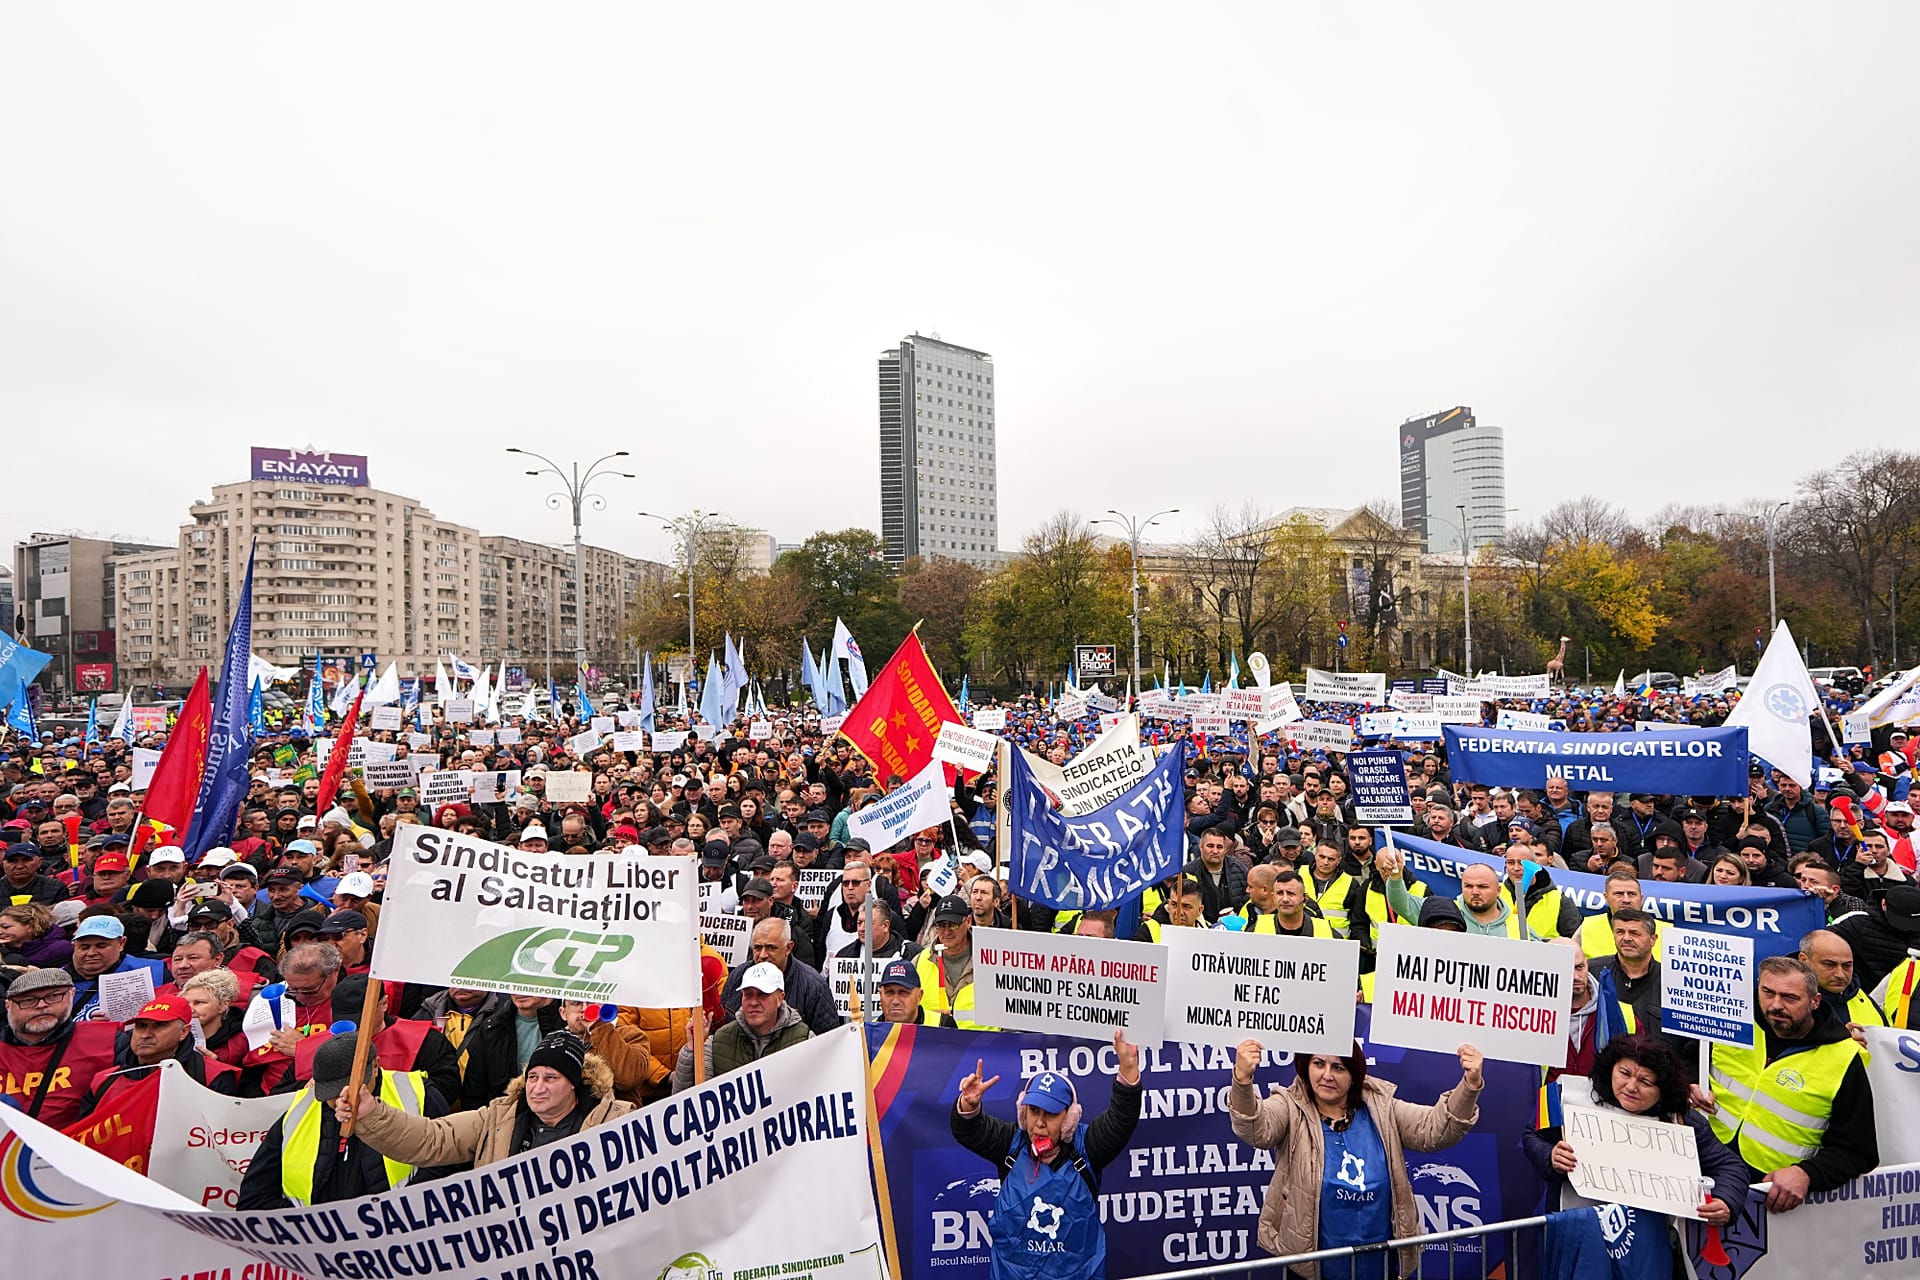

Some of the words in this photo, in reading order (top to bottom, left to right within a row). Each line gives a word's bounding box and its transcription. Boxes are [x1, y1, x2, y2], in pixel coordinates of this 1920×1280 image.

[262, 459, 358, 478] ENAYATI
[1080, 653, 1111, 661] BLACK
[1411, 719, 1438, 727] SMAR
[1518, 719, 1546, 729] SMAR
[1560, 740, 1722, 758] SINDICATELOR
[1062, 744, 1136, 782] FEDERAȚIA
[1353, 757, 1367, 766] NOI
[1368, 756, 1397, 766] PUNEM
[1358, 766, 1390, 775] ORAȘUL
[1061, 760, 1141, 800] SINDICATELO
[1365, 774, 1401, 784] MIȘCARE
[1545, 764, 1614, 782] METAL
[1355, 787, 1370, 795] VOI
[1371, 786, 1404, 796] BLOCAȚI
[1360, 795, 1403, 804] SALARIILE!
[1072, 798, 1094, 815] DIN
[412, 833, 595, 889] Sindicatul
[607, 861, 679, 890] Liber
[431, 873, 466, 903] al
[477, 876, 662, 930] Salariaților
[800, 885, 826, 896] PENTR
[1683, 935, 1731, 951] ORAȘUL
[980, 948, 998, 966] NU
[1002, 950, 1046, 971] PUTEM
[1050, 954, 1095, 976] APĂRA
[1101, 960, 1159, 983] DIGURILE
[1668, 945, 1675, 954] E
[1678, 945, 1690, 957] ÎN
[1693, 949, 1746, 966] MIȘCARE
[1192, 952, 1271, 978] OTRĂVURILE
[1274, 960, 1295, 980] DIN
[1300, 962, 1327, 982] APE
[1396, 953, 1429, 982] MAI
[1433, 958, 1490, 993] PUȚINI
[1496, 966, 1560, 999] OAMENI
[1671, 959, 1743, 981] DATORITA
[450, 976, 497, 988] COMPANIA
[512, 984, 561, 996] TRANSPORT
[563, 990, 591, 999] PUBLIC
[995, 973, 1052, 995] MUNCIND
[1057, 980, 1073, 998] PE
[1077, 982, 1140, 1005] SALARIUL
[1234, 983, 1252, 1002] NE
[1255, 986, 1282, 1005] FAC
[1683, 976, 1731, 994] NOUĂ!
[143, 1003, 170, 1013] SLPR
[1667, 987, 1694, 999] VREM
[1697, 992, 1748, 1010] DREPTATE,
[1670, 997, 1684, 1006] NU
[1686, 1000, 1742, 1017] RESTRICȚII!
[1005, 997, 1042, 1017] MINIM
[1046, 1002, 1063, 1019] PE
[1066, 1005, 1130, 1028] ECONOMIE
[1186, 1006, 1233, 1028] MUNCA
[1237, 1010, 1325, 1036] PERICULOASĂ
[1392, 990, 1425, 1019] MAI
[1430, 995, 1486, 1027] MULTE
[1492, 1002, 1557, 1036] RISCURI
[1671, 1012, 1718, 1027] SINIDICATUL
[1720, 1021, 1743, 1031] LIBER
[1679, 1021, 1735, 1039] TRANSURBAN
[1570, 1110, 1604, 1147] AȚI
[1612, 1119, 1697, 1160] DISTRUS
[162, 1209, 359, 1245] SINDICATUL
[357, 1141, 597, 1239] SALARIAȚILOR
[599, 1115, 657, 1172] DIN
[663, 1068, 772, 1147] CADRUL
[314, 1213, 535, 1280] AGRICULTURII
[575, 1125, 759, 1235] DEZVOLTĂRII
[763, 1091, 858, 1156] RURALE
[1336, 1187, 1375, 1202] SMAR
[1098, 1185, 1269, 1229] JUDEȚEA
[1413, 1194, 1484, 1239] NS
[1882, 1203, 1920, 1230] FILIA
[931, 1210, 994, 1252] BN
[1027, 1239, 1066, 1253] SMAR
[1163, 1229, 1249, 1263] CLUJ
[1864, 1237, 1907, 1264] SATU
[733, 1264, 781, 1280] FEDERAȚIA
[781, 1253, 845, 1274] SINDICATELOR
[930, 1256, 959, 1267] Blocul
[960, 1254, 991, 1266] Națion
